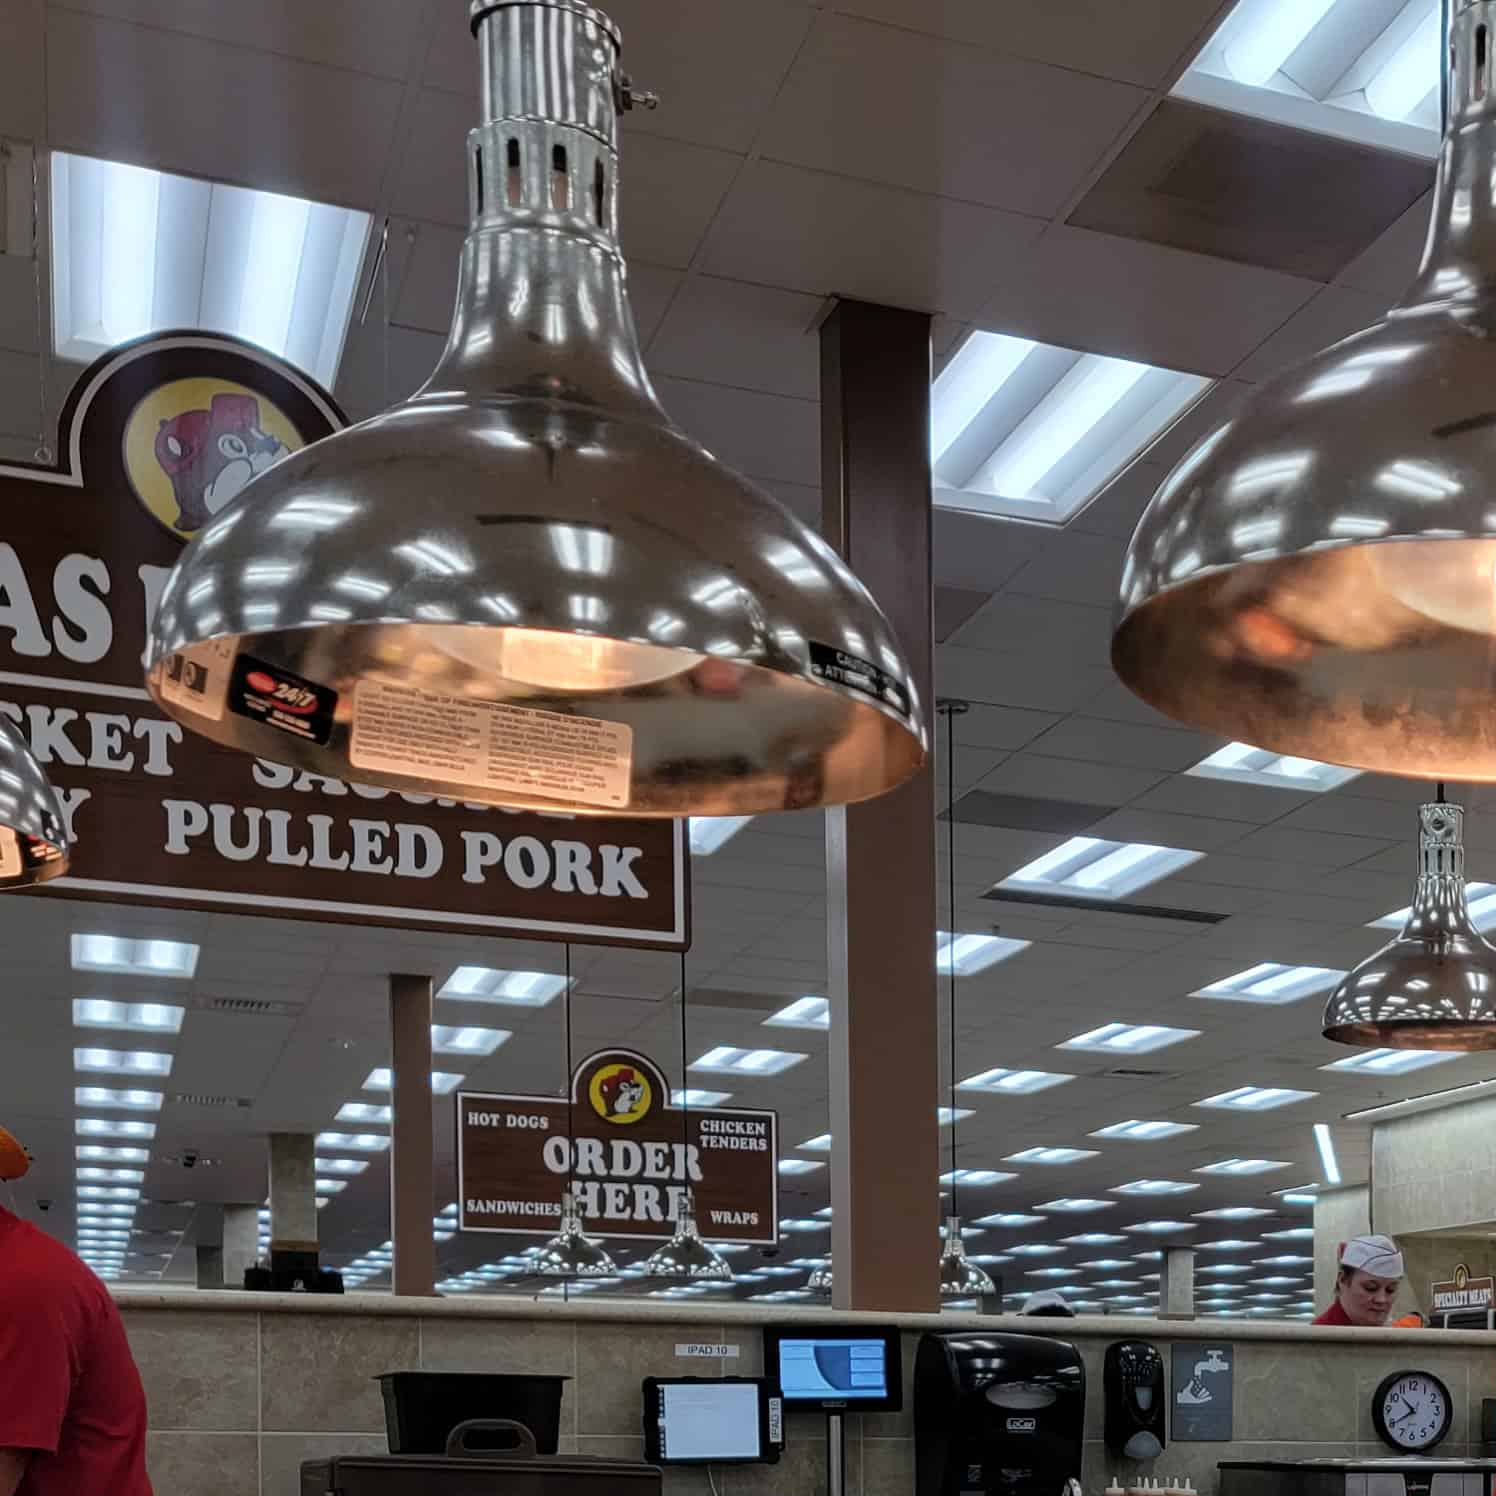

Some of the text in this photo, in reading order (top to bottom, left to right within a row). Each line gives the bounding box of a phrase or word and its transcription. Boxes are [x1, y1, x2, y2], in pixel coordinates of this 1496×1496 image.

[163, 799, 444, 879] PULLED
[461, 830, 649, 899] PORK
[468, 1111, 549, 1130] HOT DOGS
[700, 1119, 766, 1135] CHICKEN
[700, 1134, 767, 1151] TENDERS
[543, 1135, 703, 1181] ORDER
[466, 1199, 562, 1217] SANDWICHES
[710, 1210, 759, 1226] WRAPS
[1408, 1380, 1419, 1391] 12
[1391, 1393, 1400, 1403] 10
[1430, 1394, 1437, 1404] 2
[1385, 1404, 1392, 1415] 9
[1434, 1405, 1441, 1416] 3
[1399, 1427, 1406, 1437] 7
[1408, 1431, 1416, 1441] 6
[1420, 1428, 1427, 1439] 5
